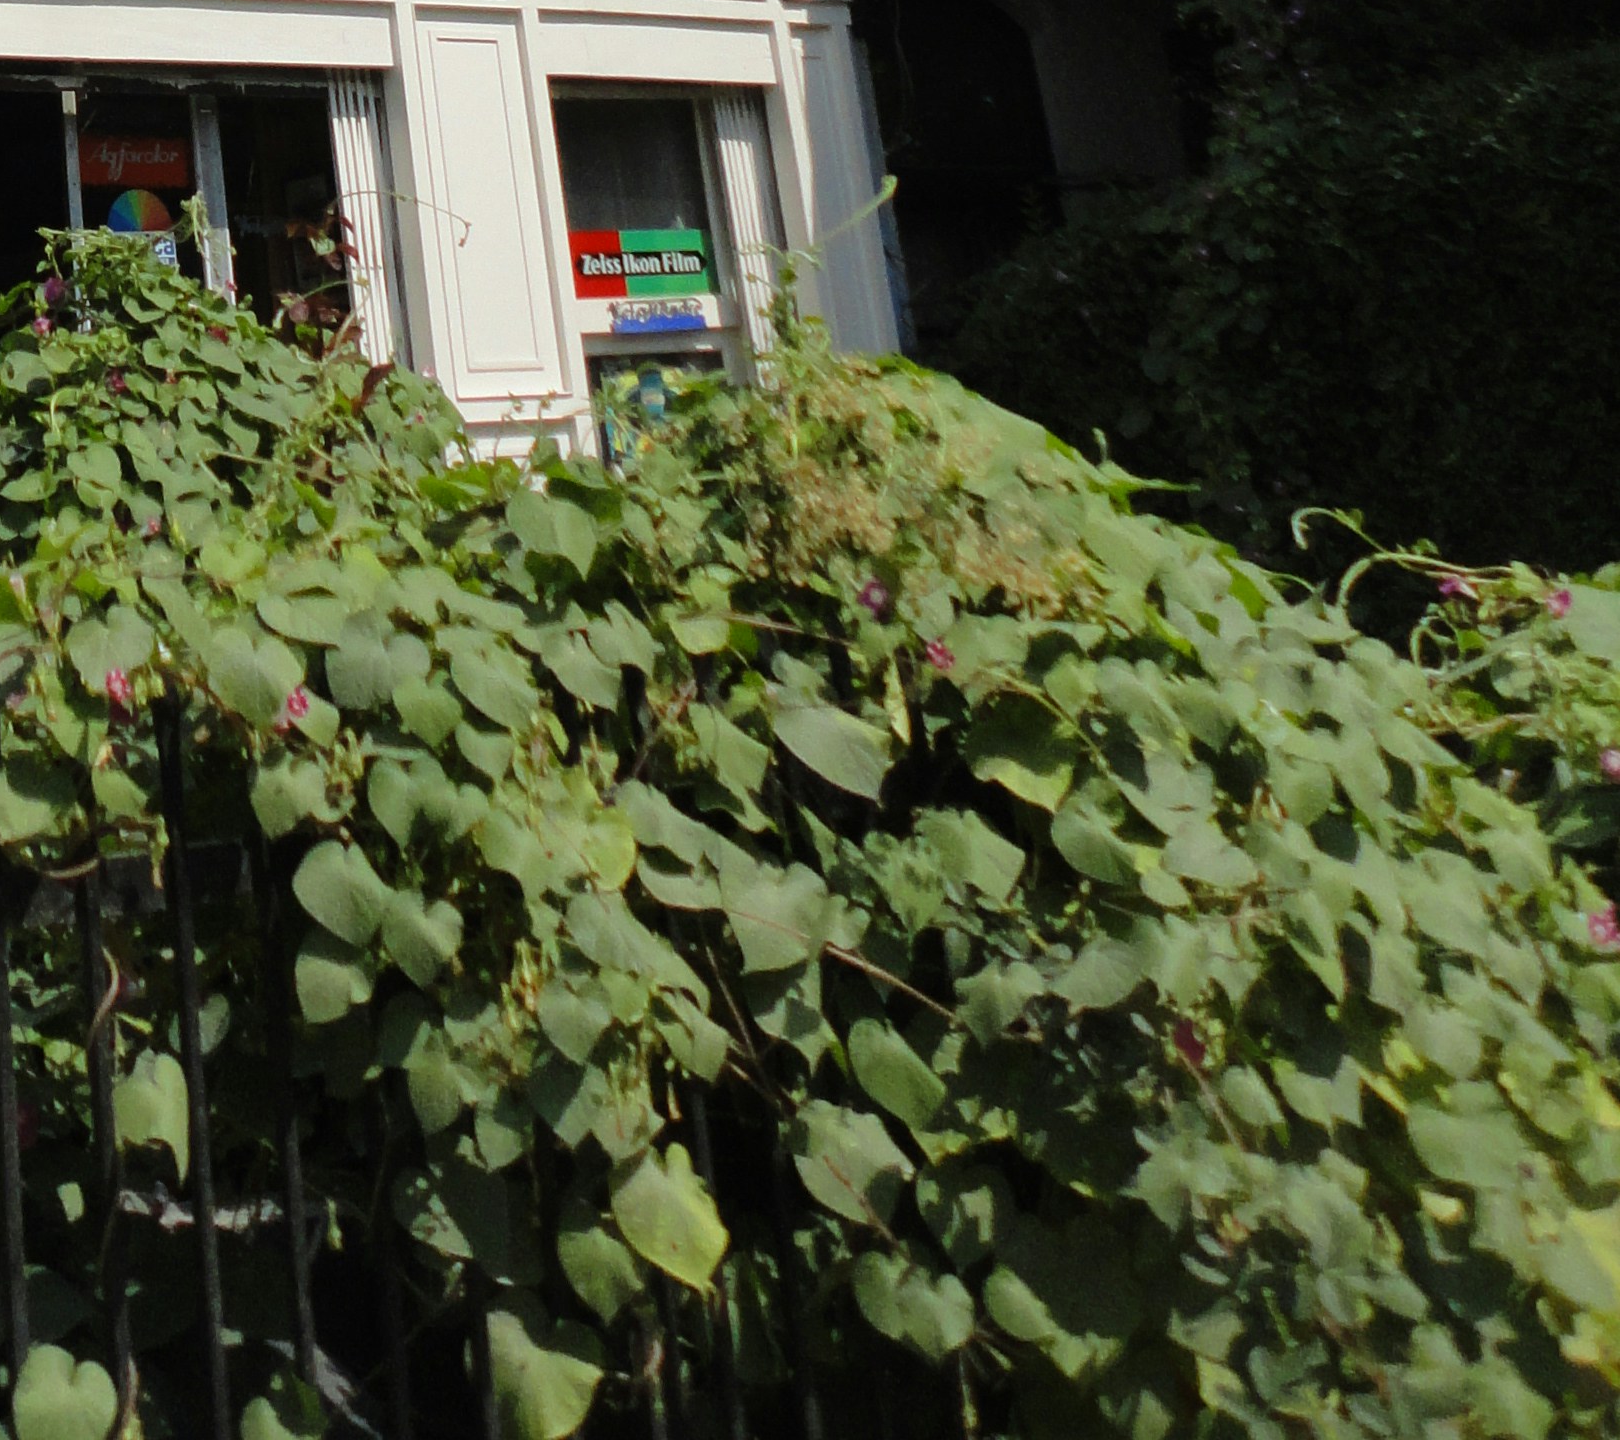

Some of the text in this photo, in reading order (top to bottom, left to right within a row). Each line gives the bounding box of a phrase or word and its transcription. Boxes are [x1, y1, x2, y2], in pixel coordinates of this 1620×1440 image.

[581, 251, 701, 275] Zeiss Ikon Film
